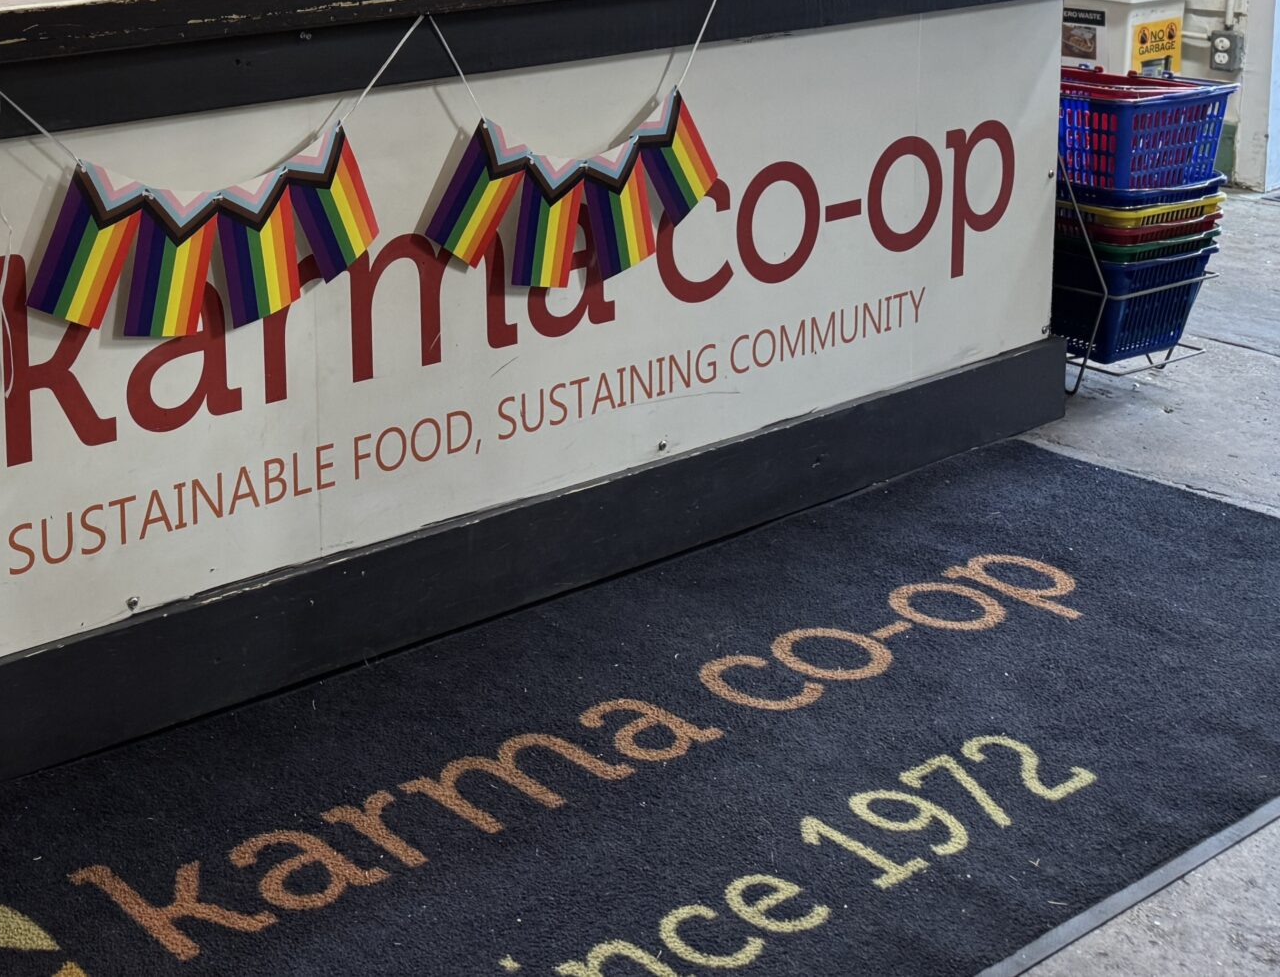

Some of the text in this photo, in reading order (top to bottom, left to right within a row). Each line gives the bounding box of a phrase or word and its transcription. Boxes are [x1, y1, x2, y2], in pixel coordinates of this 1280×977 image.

[1078, 12, 1102, 21] WASTE
[1138, 40, 1176, 56] GARBAGE
[1150, 29, 1165, 42] NO
[656, 120, 1016, 304] co-op
[6, 286, 927, 576] SUSTAINABLE FOOD, SUSTAINING COMMUNITY
[65, 553, 1084, 962] karma co-op
[800, 733, 1098, 889] 1972
